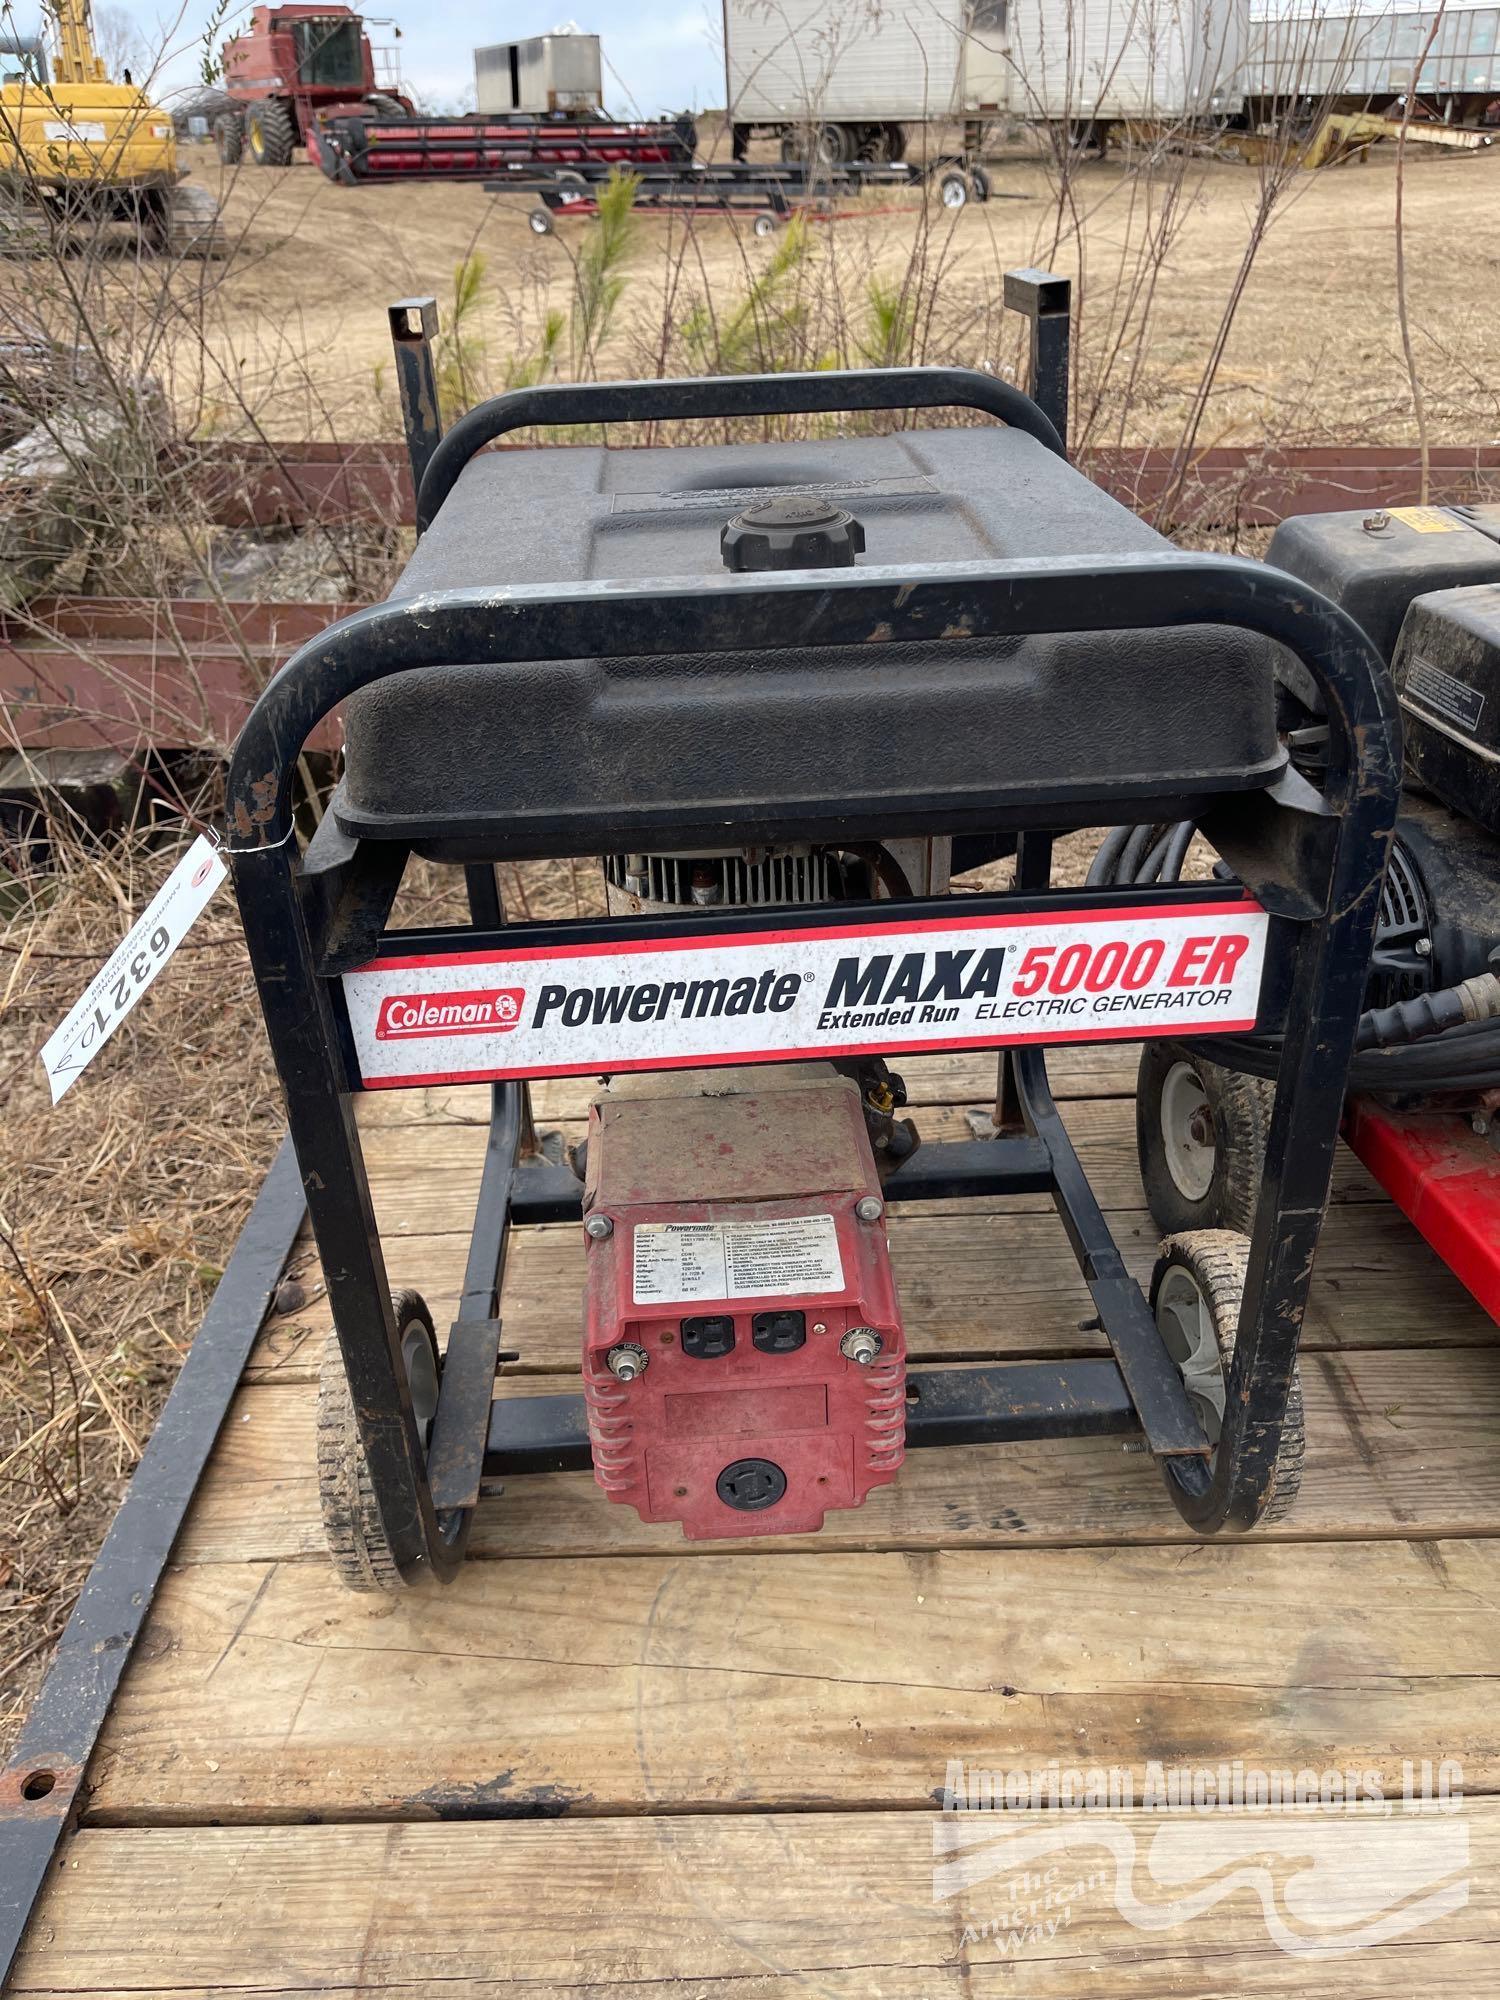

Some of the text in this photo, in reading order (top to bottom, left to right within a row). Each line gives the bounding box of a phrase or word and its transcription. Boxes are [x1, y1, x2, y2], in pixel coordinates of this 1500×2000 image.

[140, 882, 181, 942] AMERICAN
[80, 942, 139, 1019] AUCTIONEERS
[93, 925, 171, 1035] 6321
[531, 968, 802, 1029] Powermate
[823, 934, 1249, 1008] MAXA 5000 ER
[63, 1019, 80, 1043] LLC
[386, 996, 491, 1028] Coleman
[817, 989, 1233, 1030] Extended Run ELECTRIC GENERATOR
